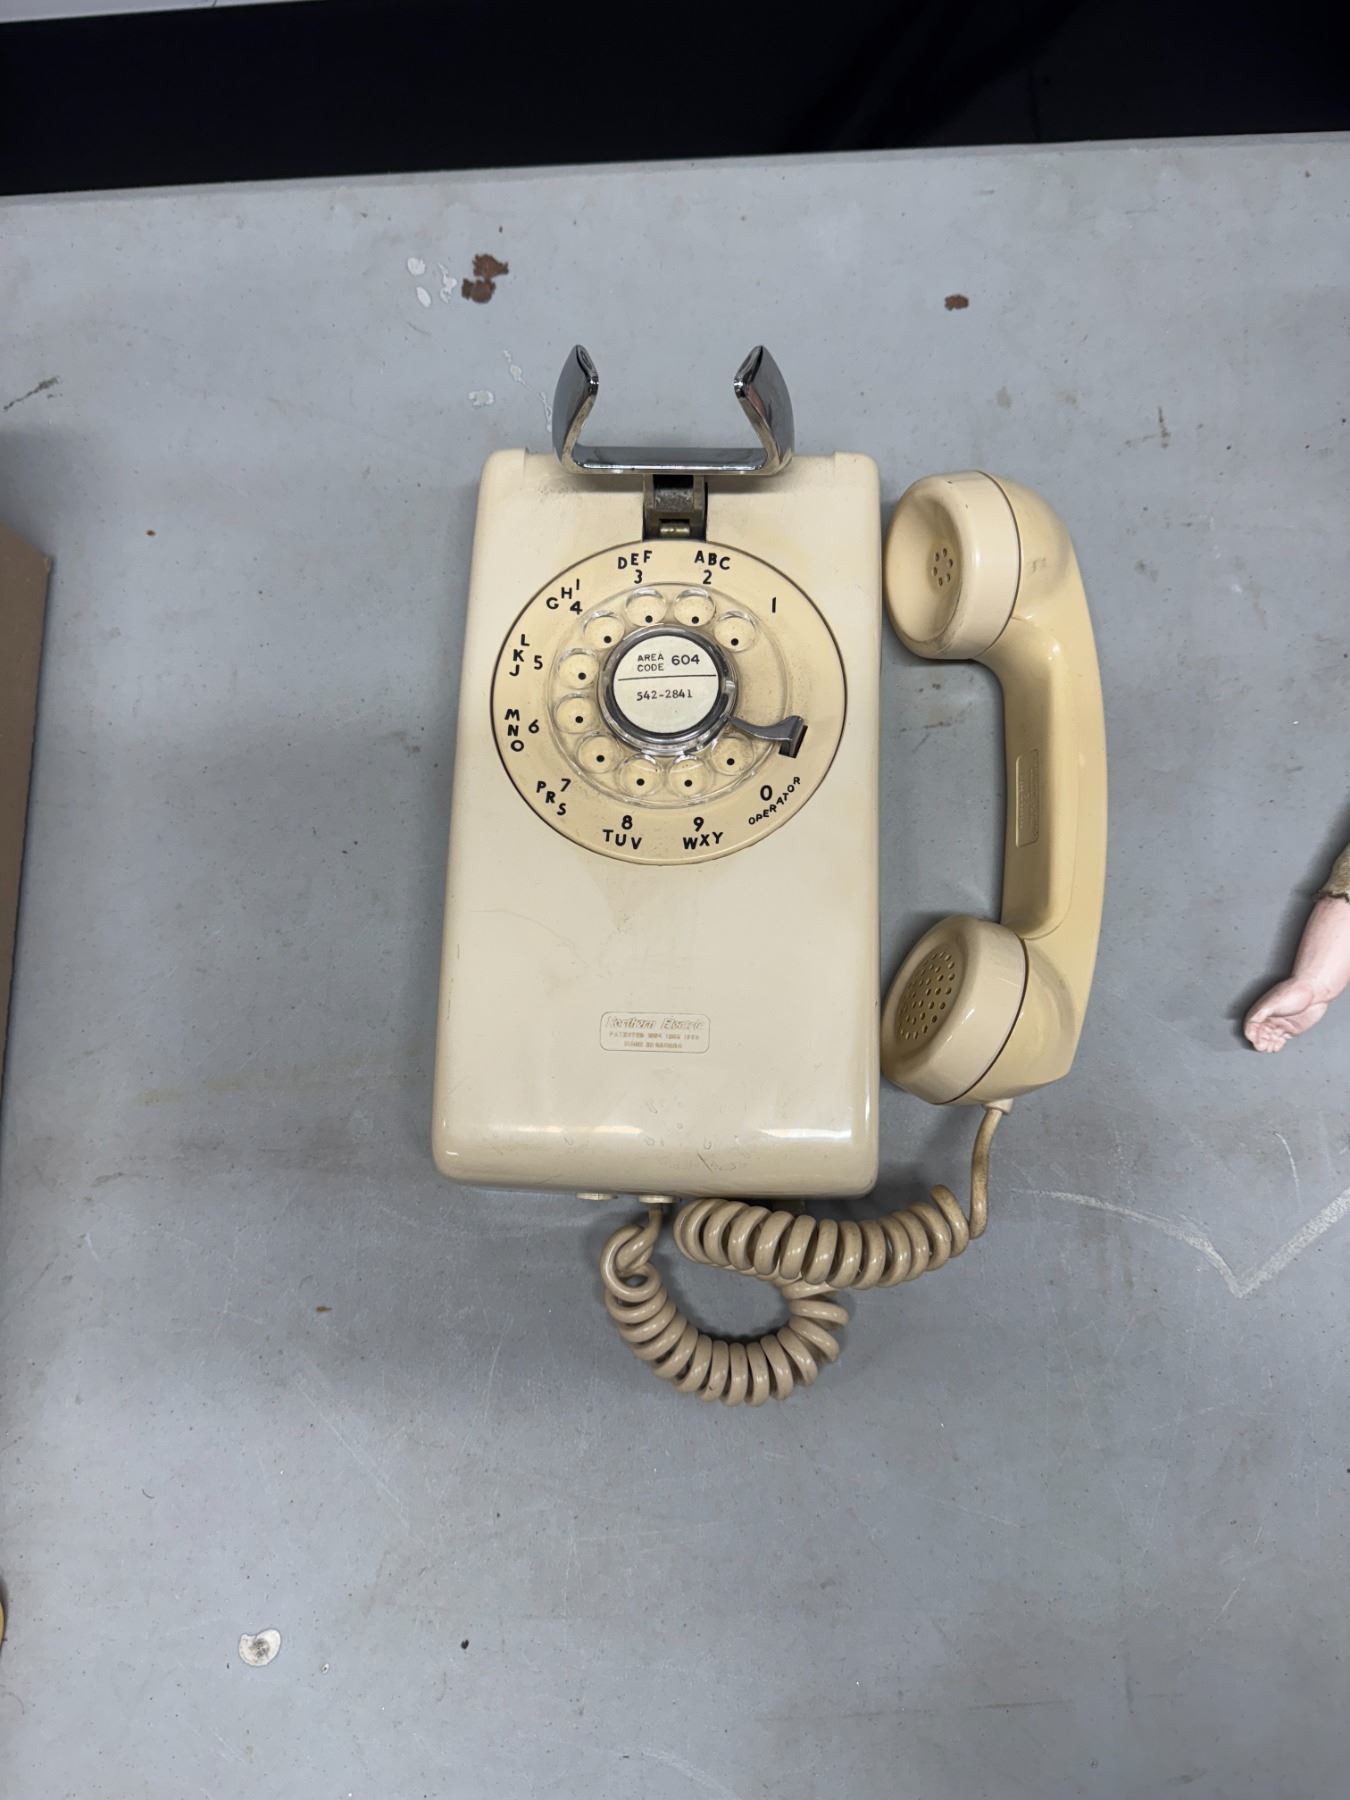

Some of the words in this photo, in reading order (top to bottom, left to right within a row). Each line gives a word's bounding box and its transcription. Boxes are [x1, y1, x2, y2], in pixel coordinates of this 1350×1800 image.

[617, 550, 653, 569] DEF
[694, 550, 731, 570] ABC
[633, 569, 643, 584] 3
[702, 570, 713, 584] 2
[570, 601, 583, 615] 4
[771, 597, 777, 613] 1
[533, 655, 543, 670] 5
[637, 653, 664, 662] AREA
[671, 654, 700, 666] 604
[637, 663, 664, 672] CODE
[636, 689, 693, 701] 542-2841
[528, 719, 540, 734] 6
[560, 778, 571, 792] 7
[748, 776, 801, 825] OPERATOR
[621, 815, 633, 830] 8
[693, 817, 704, 832] 9
[602, 829, 642, 850] TUV
[682, 832, 723, 850] WXY
